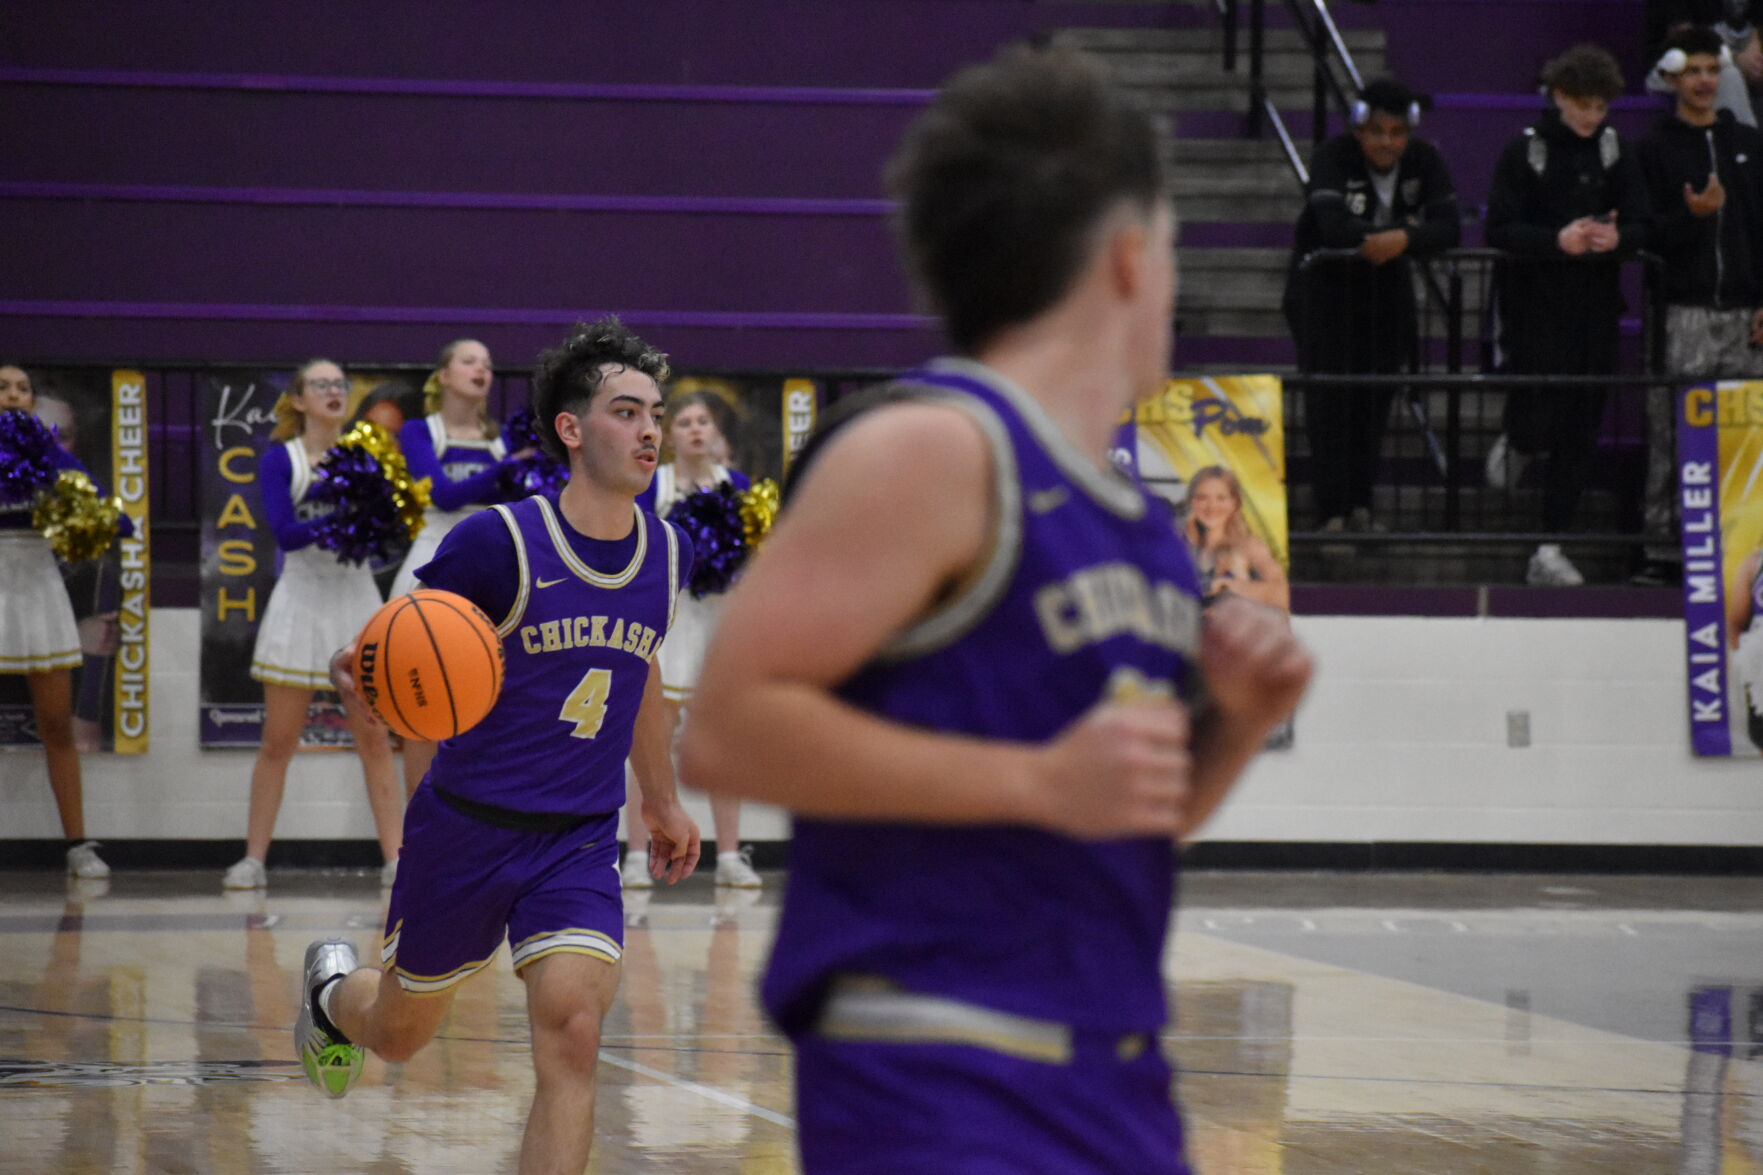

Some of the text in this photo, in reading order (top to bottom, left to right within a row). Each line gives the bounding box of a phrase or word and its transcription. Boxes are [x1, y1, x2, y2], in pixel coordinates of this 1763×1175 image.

[788, 390, 812, 460] EER
[118, 383, 145, 738] CHICKASHA CHEER
[217, 446, 258, 622] CASH
[1682, 461, 1723, 722] KAIA MILLER
[558, 668, 613, 740] 4
